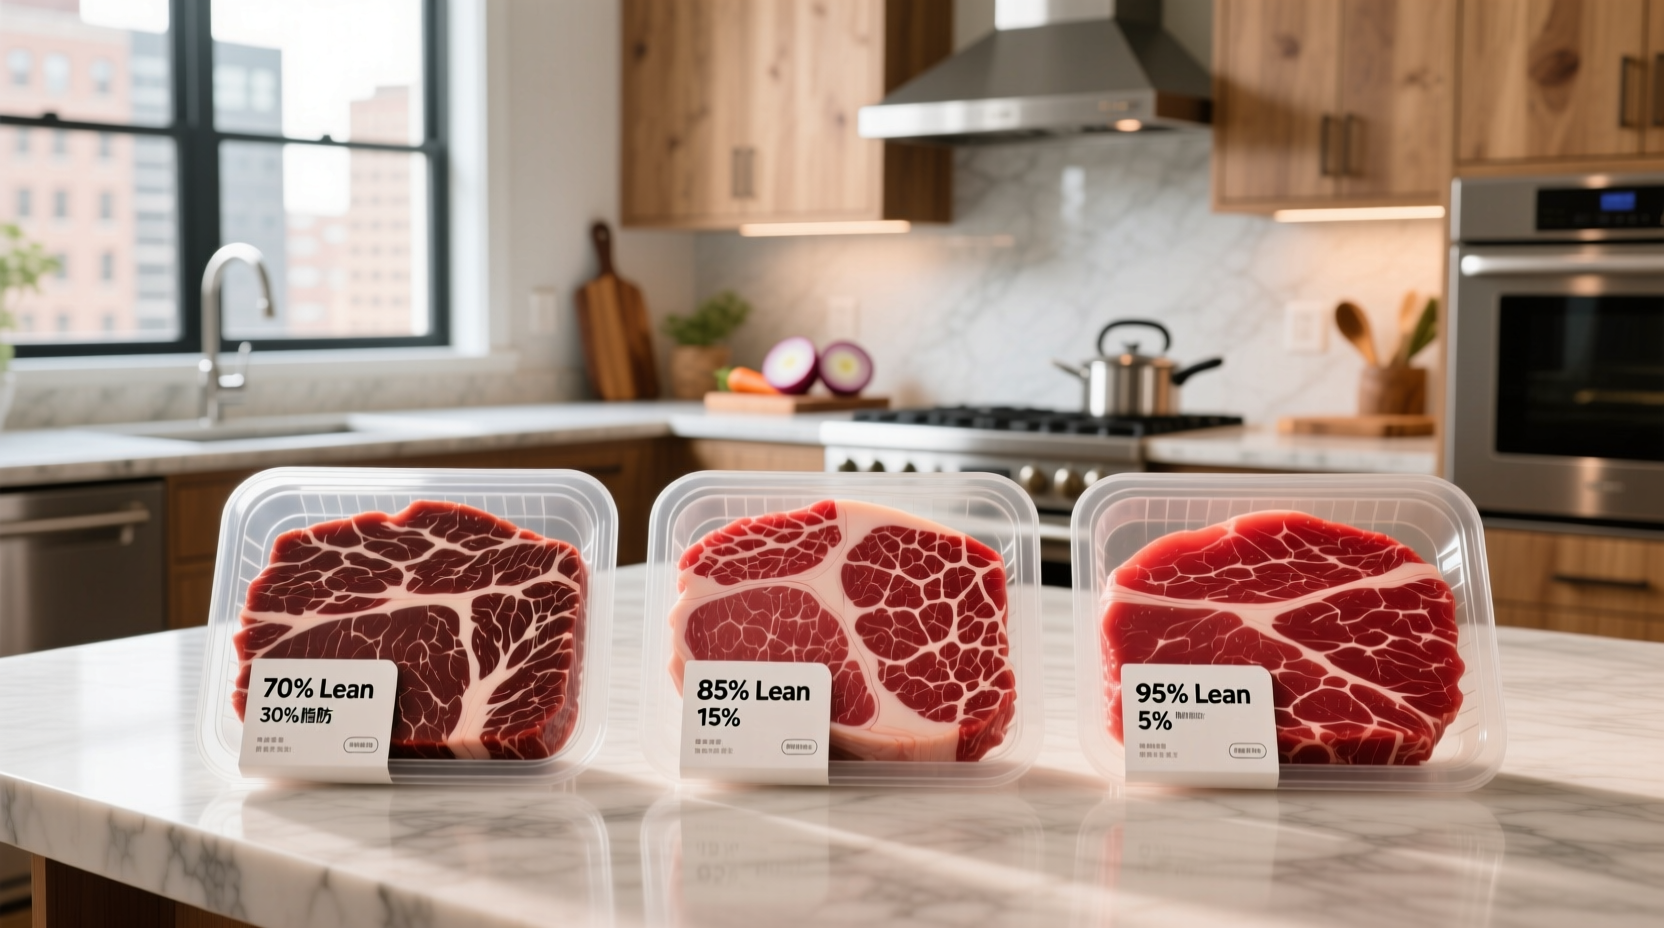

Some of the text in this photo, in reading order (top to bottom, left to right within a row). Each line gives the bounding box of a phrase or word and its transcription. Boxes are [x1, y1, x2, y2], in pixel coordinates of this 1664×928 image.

[263, 677, 374, 699] 70% Lean
[697, 679, 810, 701] 85% Lean
[1135, 683, 1251, 704] 95% Lean
[697, 707, 741, 727] 15%
[1138, 710, 1173, 731] 5%
